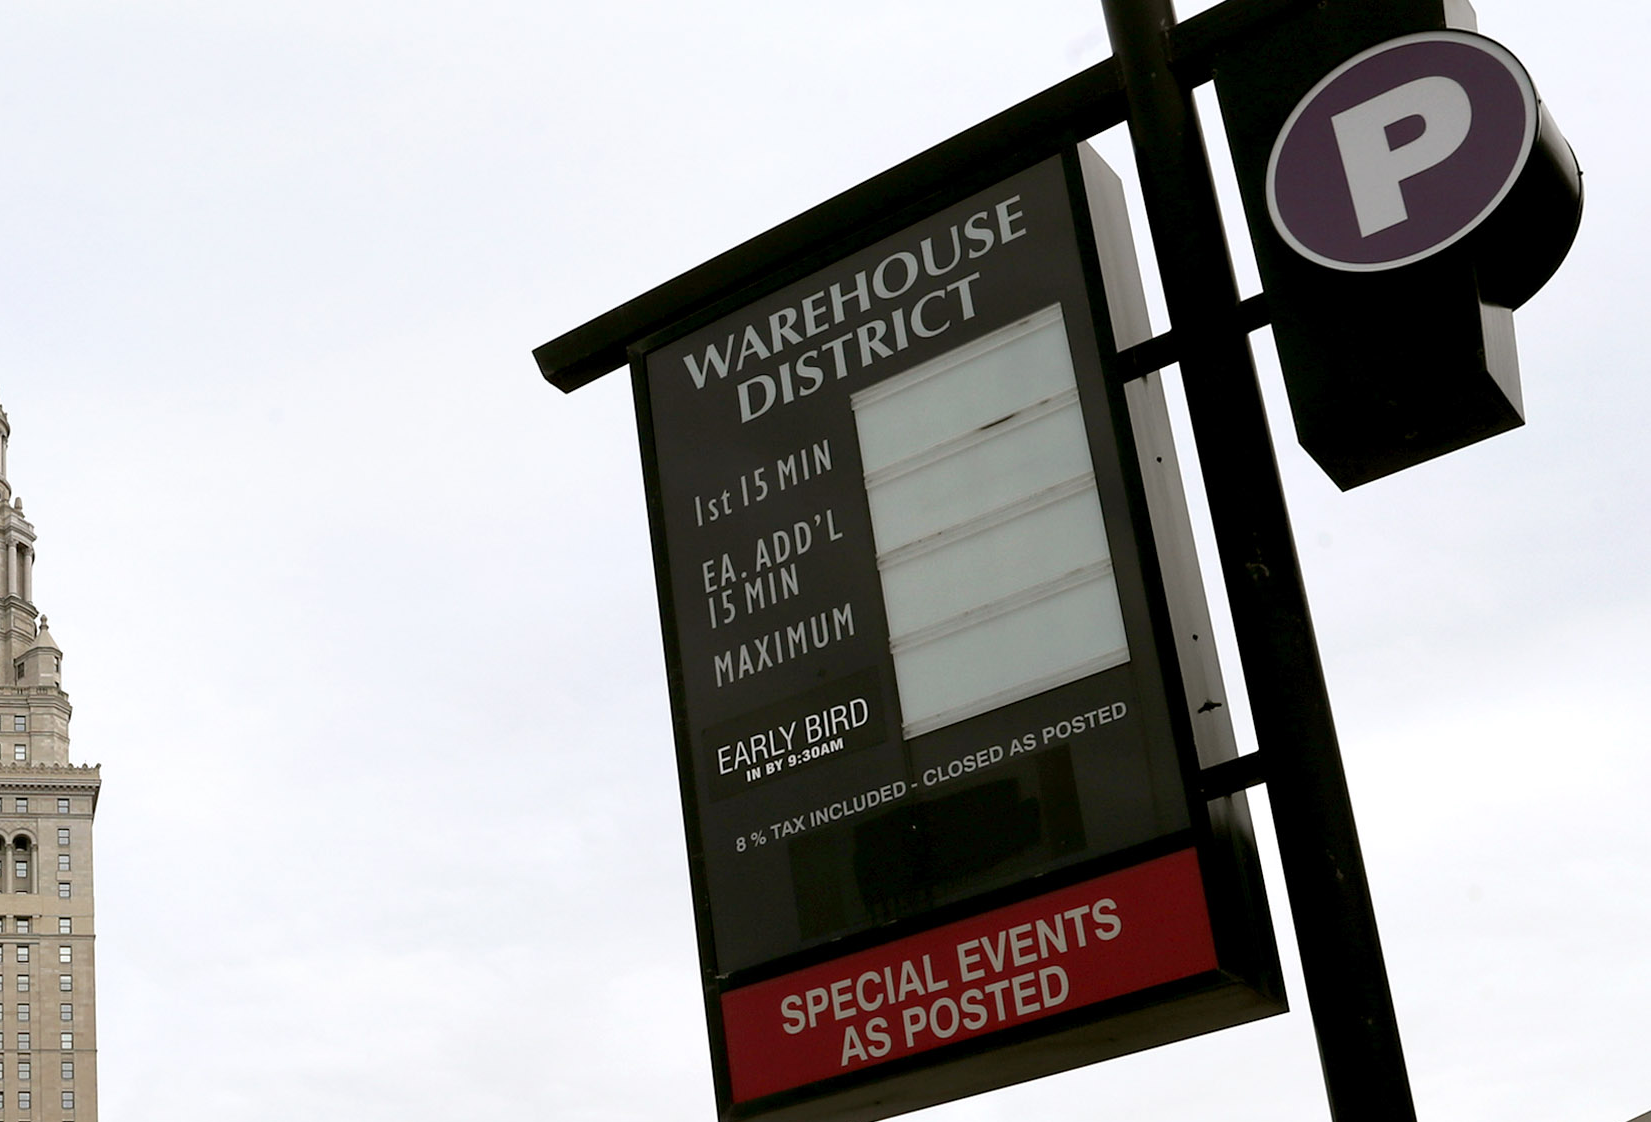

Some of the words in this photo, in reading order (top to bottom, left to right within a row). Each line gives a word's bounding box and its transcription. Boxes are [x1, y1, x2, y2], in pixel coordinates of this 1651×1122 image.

[1330, 75, 1473, 239] P
[682, 194, 1027, 390] WAREHOUSE
[737, 271, 980, 424] DISTRICT
[694, 489, 733, 527] 1st
[740, 467, 768, 507] 15
[776, 439, 832, 491] MIN
[702, 553, 747, 594] EA.
[756, 509, 843, 572] ADD'L
[708, 589, 736, 629] 15
[744, 563, 799, 614] MIN
[714, 602, 855, 688] MAXIMUM
[717, 721, 797, 775] EARLY
[804, 698, 869, 744] BIRD
[746, 766, 762, 783] IN
[765, 758, 784, 776] BY
[787, 737, 844, 767] 9:30AM
[770, 815, 806, 840] TAX
[809, 781, 906, 827] INCLUDED
[923, 745, 1004, 786] CLOSED
[1009, 733, 1037, 757] AS
[1042, 702, 1127, 744] POSTED
[780, 954, 949, 1035] SPECIAL
[956, 898, 1122, 983] EVENTS
[841, 1016, 892, 1067] AS
[902, 965, 1069, 1048] POSTED
